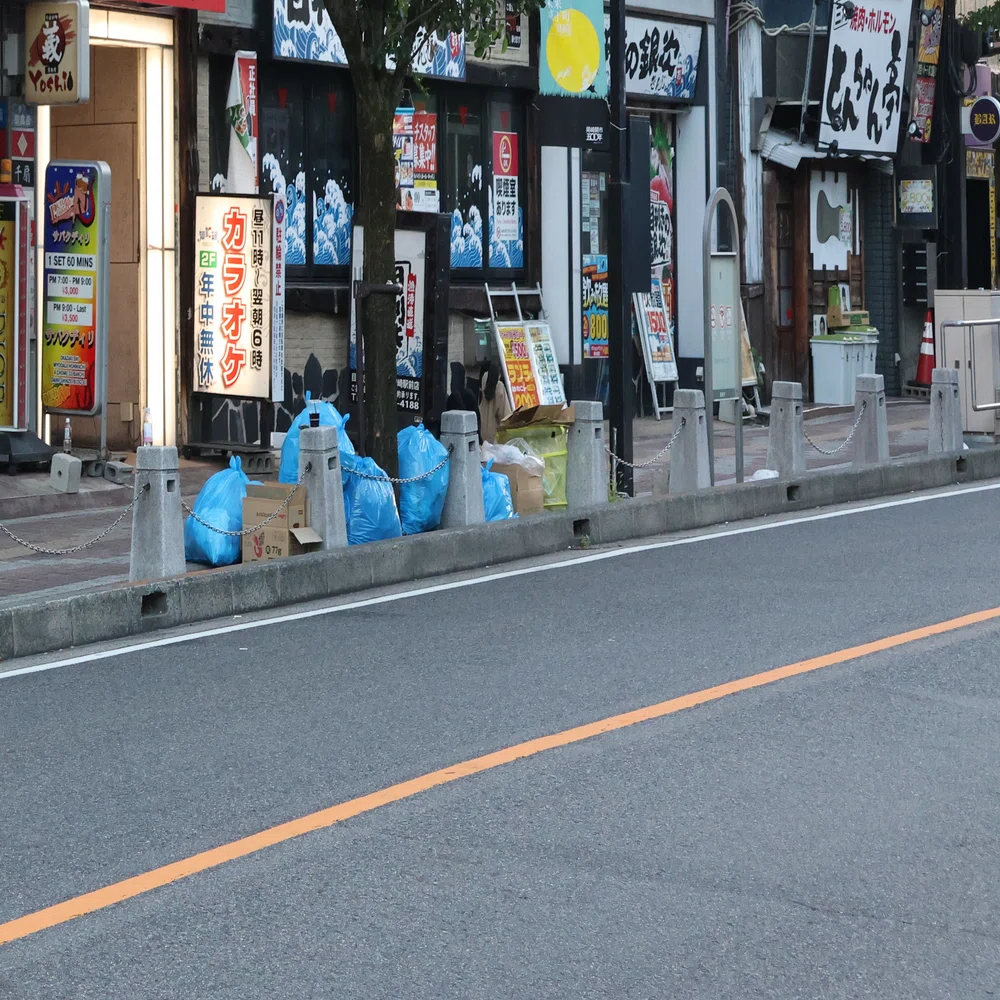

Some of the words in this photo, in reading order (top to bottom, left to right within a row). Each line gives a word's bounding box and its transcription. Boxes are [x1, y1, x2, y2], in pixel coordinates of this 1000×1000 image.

[974, 113, 996, 126] BAR
[14, 164, 31, 184] 千扇
[495, 178, 517, 198] 喫煙室
[495, 201, 517, 217] あります
[53, 255, 66, 267] SET
[66, 256, 75, 267] 60
[76, 257, 94, 268] MINS
[200, 251, 217, 268] 2F
[48, 275, 57, 284] PM
[57, 276, 69, 285] 7:00
[72, 277, 81, 285] PM
[80, 277, 92, 286] 9:00
[221, 206, 248, 388] カラオケ
[53, 303, 61, 312] PM
[61, 304, 73, 312] 9:00
[76, 305, 87, 313] Last
[200, 271, 215, 386] 年中無休
